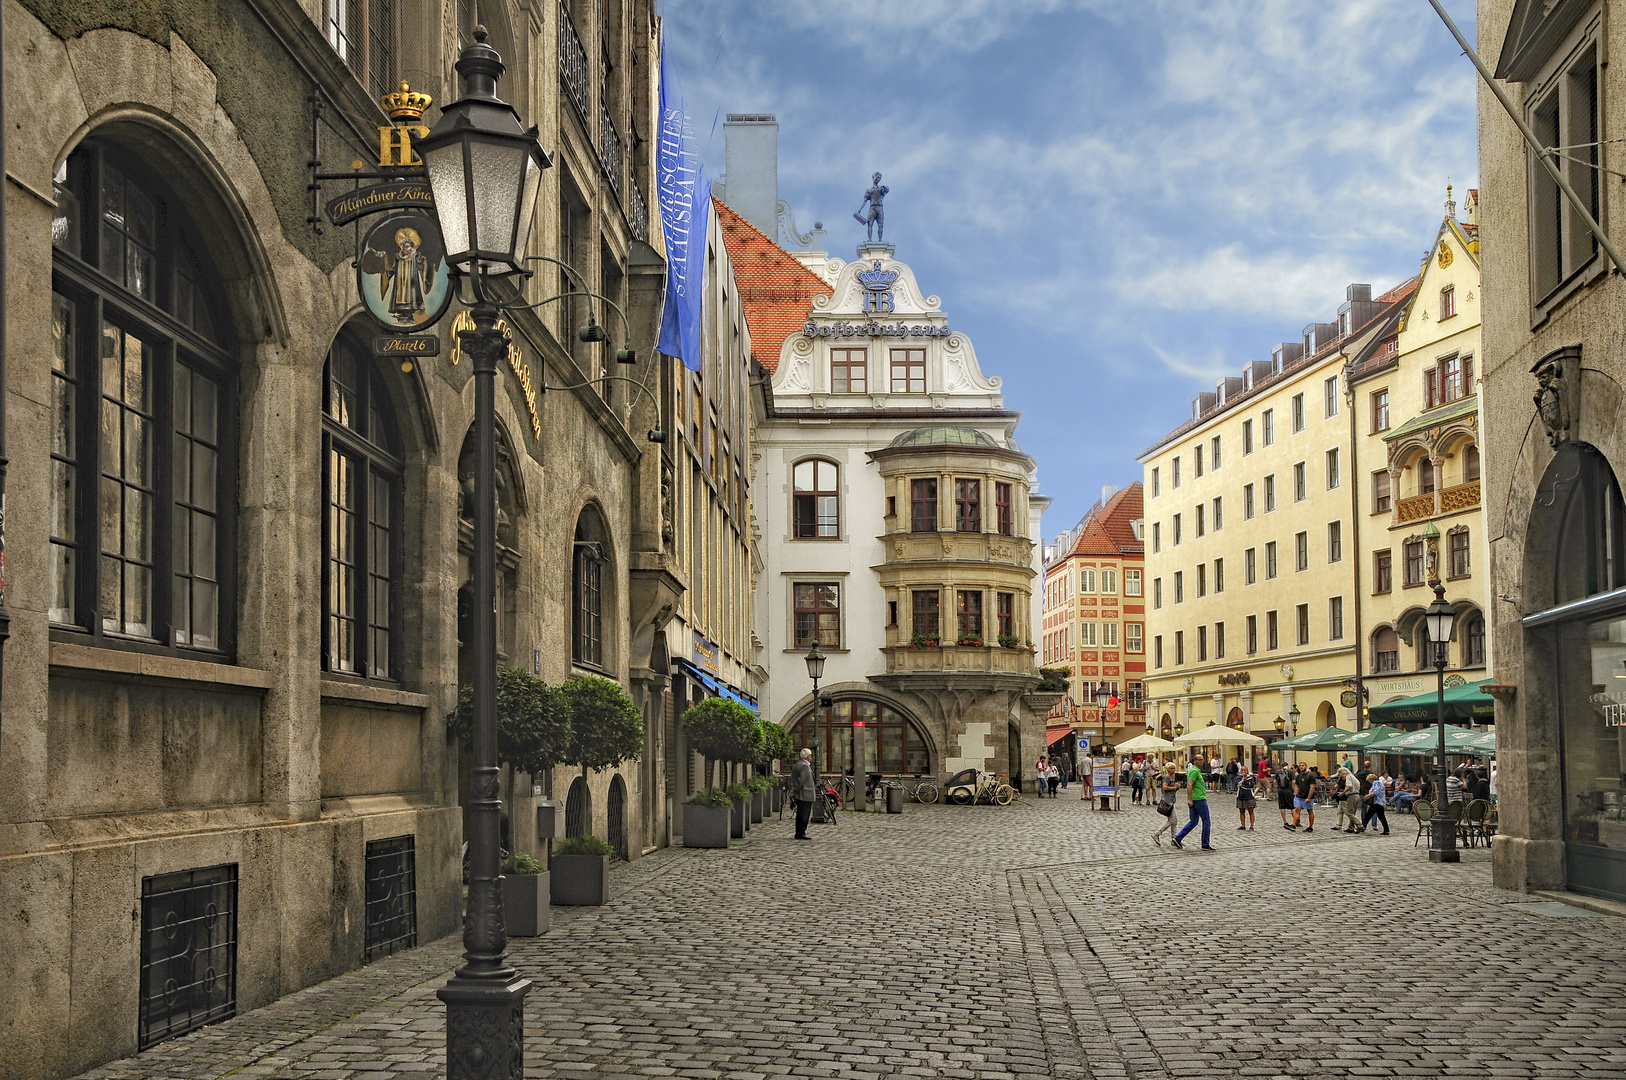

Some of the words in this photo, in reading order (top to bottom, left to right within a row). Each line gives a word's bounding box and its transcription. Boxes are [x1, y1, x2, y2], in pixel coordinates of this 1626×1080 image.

[660, 108, 685, 251] ERISCHES
[333, 189, 397, 220] Münchner
[862, 290, 896, 313] HB
[802, 319, 953, 340] Hofbräuhaus
[383, 339, 418, 352] Platzl
[418, 339, 427, 351] 6
[1380, 681, 1421, 691] WIRTSHAUS
[1393, 709, 1428, 719] ORLANDO
